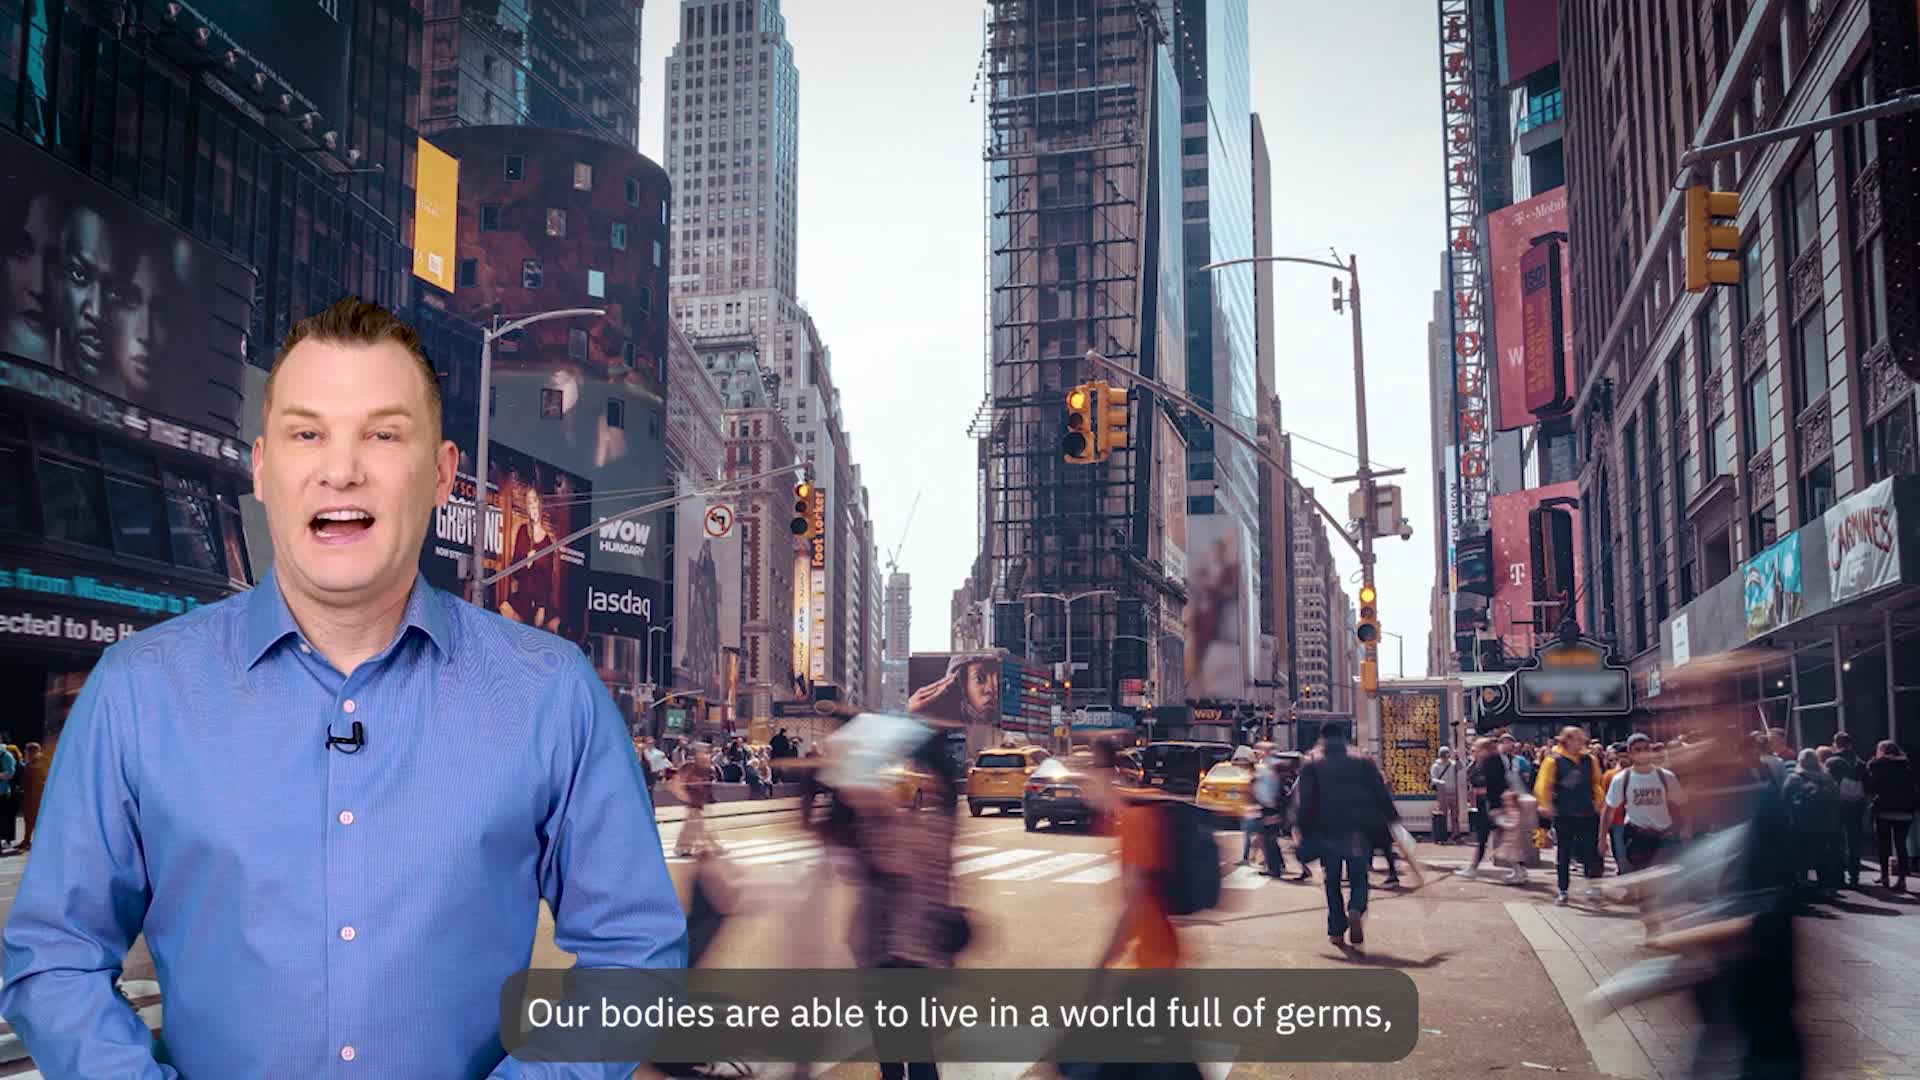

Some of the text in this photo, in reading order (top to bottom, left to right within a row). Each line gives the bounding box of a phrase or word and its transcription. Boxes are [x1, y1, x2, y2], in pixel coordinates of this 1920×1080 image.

[1455, 290, 1482, 478] YOUNG
[600, 517, 651, 545] WOW
[599, 540, 646, 557] HUNGARY
[1509, 563, 1526, 586] T
[64, 617, 88, 640] to
[90, 619, 116, 643] be
